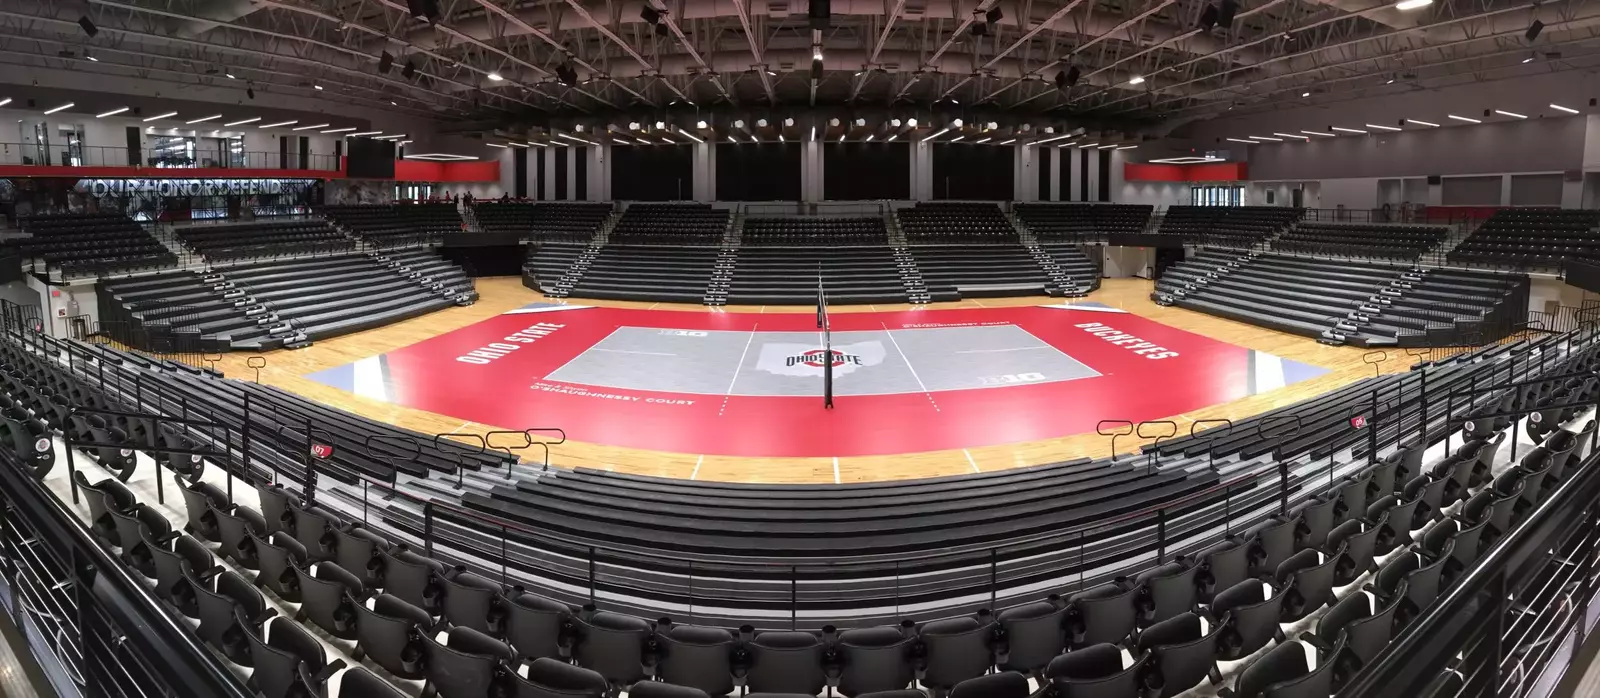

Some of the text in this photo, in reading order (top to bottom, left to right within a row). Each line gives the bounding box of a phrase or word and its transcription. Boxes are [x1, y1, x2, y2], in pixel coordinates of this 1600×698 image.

[140, 179, 214, 198] HONOR
[219, 179, 281, 196] DEFEND
[456, 322, 566, 364] OHIO STATE
[1073, 322, 1179, 360] BUCKEYES
[818, 353, 863, 366] SATE
[530, 385, 641, 402] O'SHAUGHNESSY
[645, 397, 696, 406] COURT
